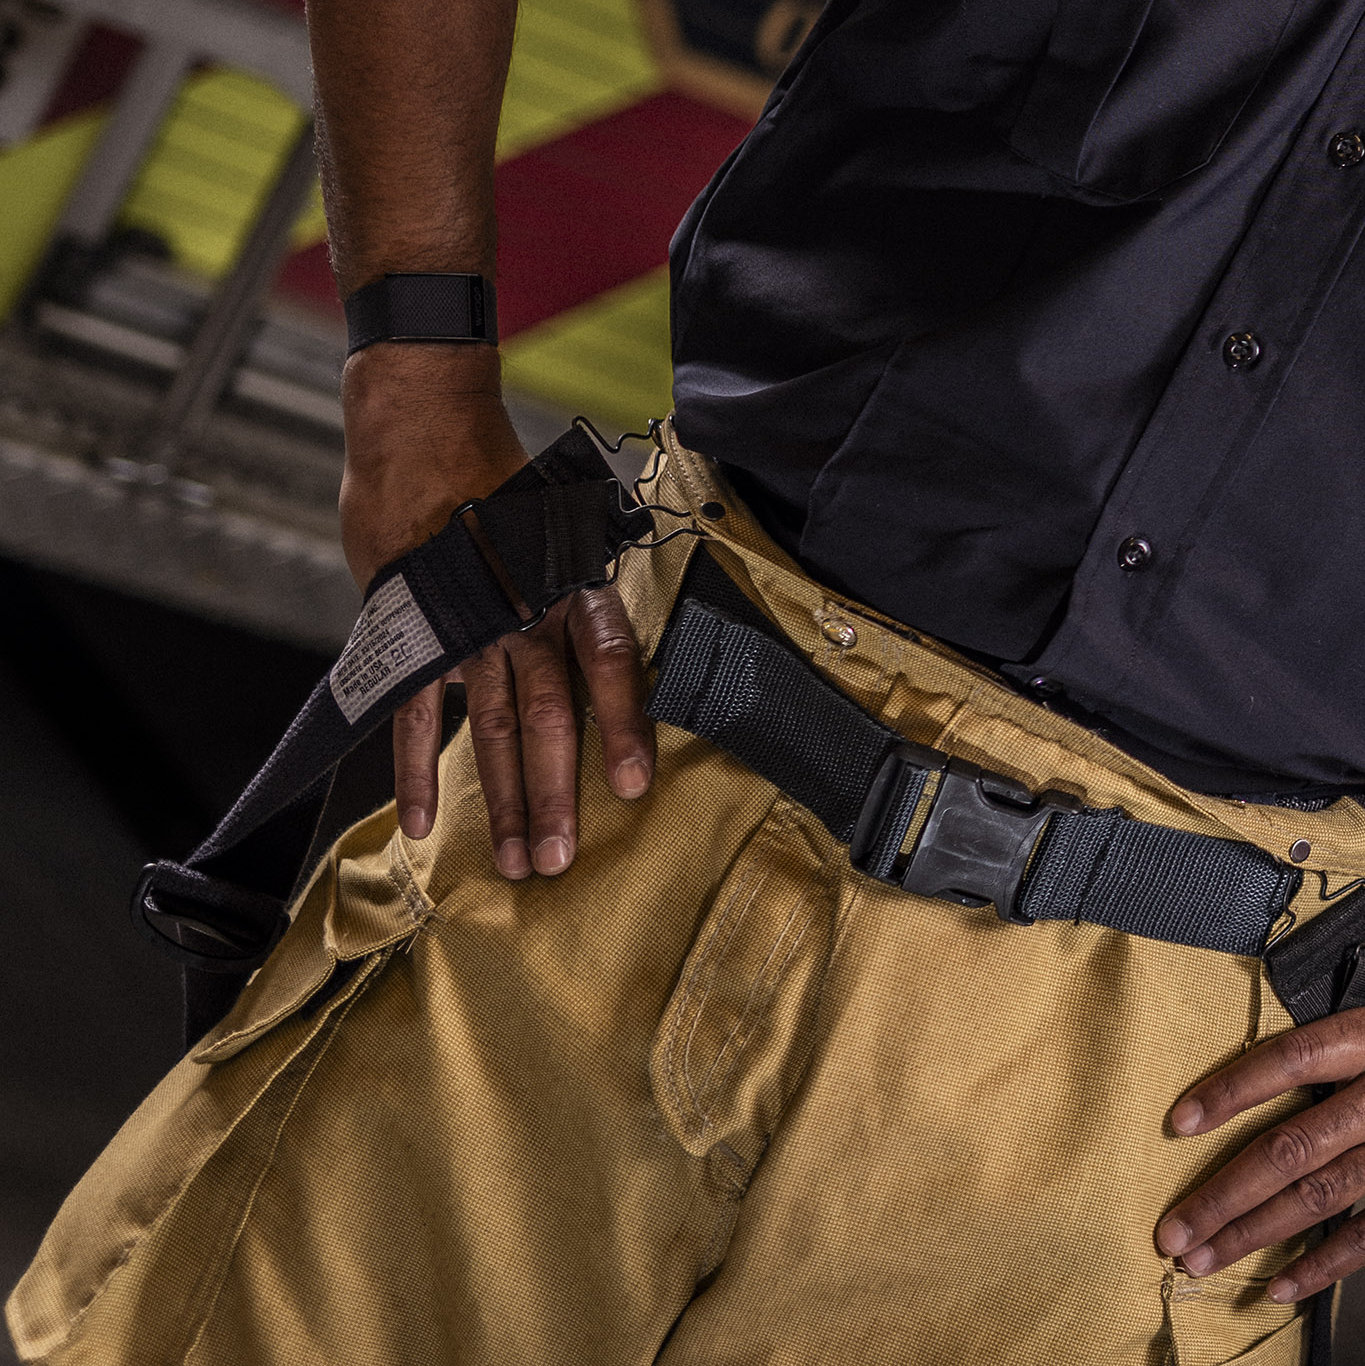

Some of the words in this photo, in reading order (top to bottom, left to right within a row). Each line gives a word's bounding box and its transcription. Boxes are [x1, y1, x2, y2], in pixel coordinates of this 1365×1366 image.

[342, 679, 362, 697] Made
[369, 659, 384, 675] USA
[361, 666, 392, 696] REGULAR
